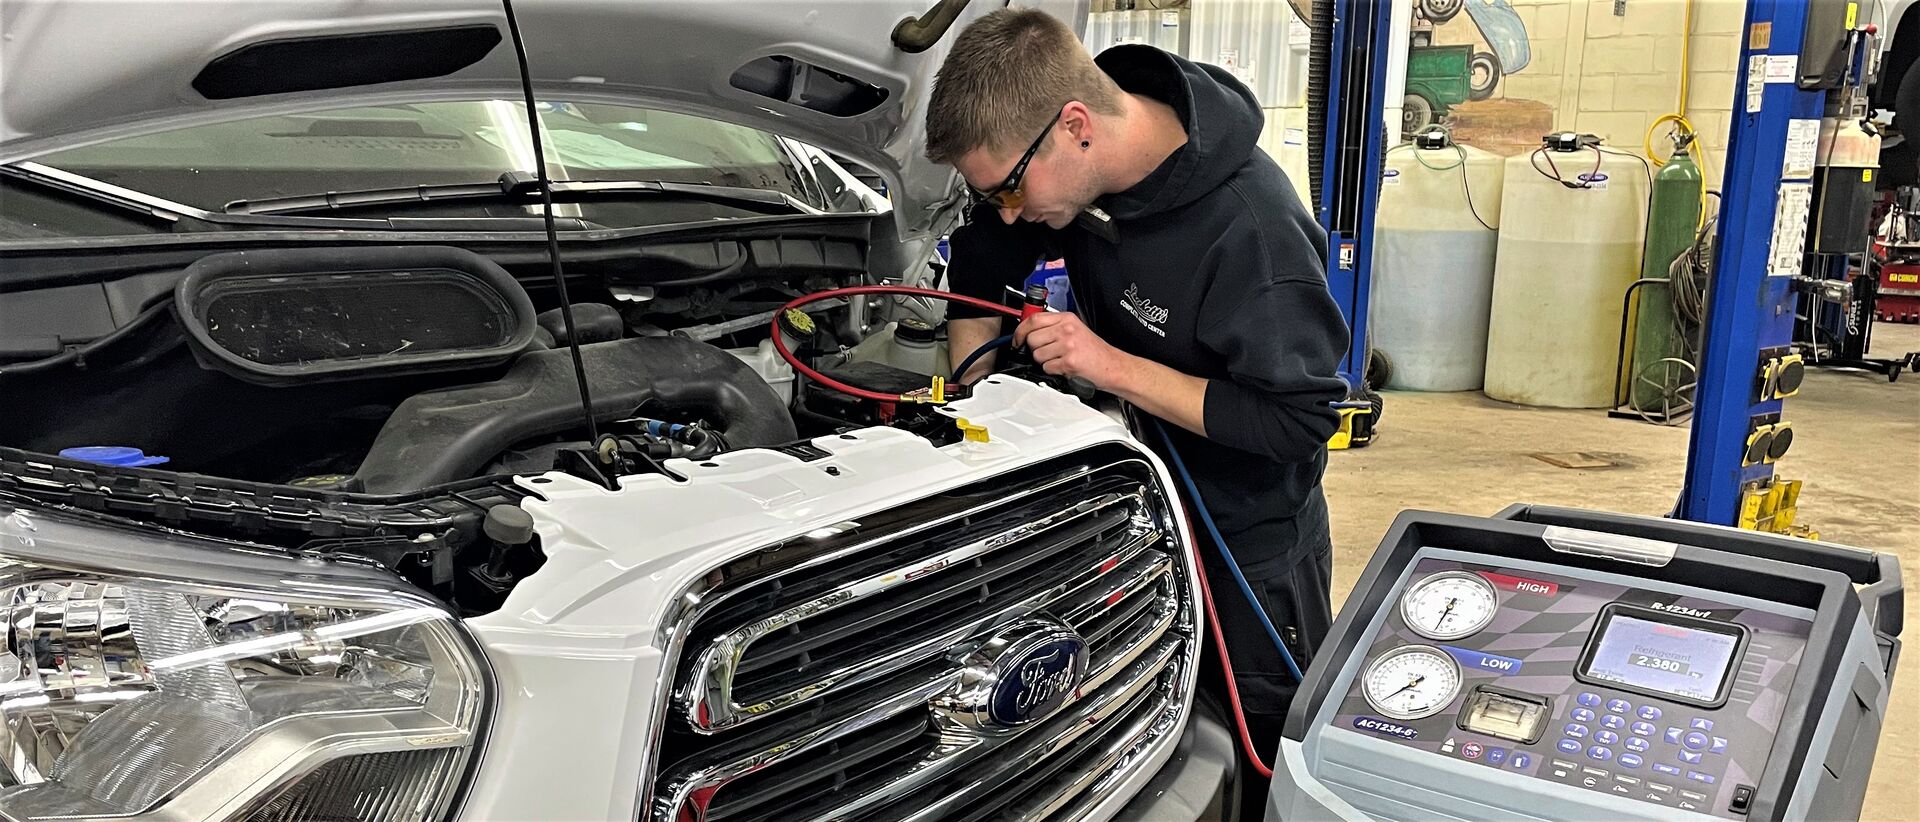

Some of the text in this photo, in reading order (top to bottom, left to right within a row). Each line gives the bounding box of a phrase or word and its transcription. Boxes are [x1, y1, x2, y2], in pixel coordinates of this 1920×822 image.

[1148, 324, 1166, 338] CENTER
[1516, 581, 1549, 594] HIGH
[1480, 657, 1513, 671] LOW
[1636, 655, 1680, 672] 2.380
[1016, 648, 1075, 715] Ford
[1561, 742, 1577, 750] HELP
